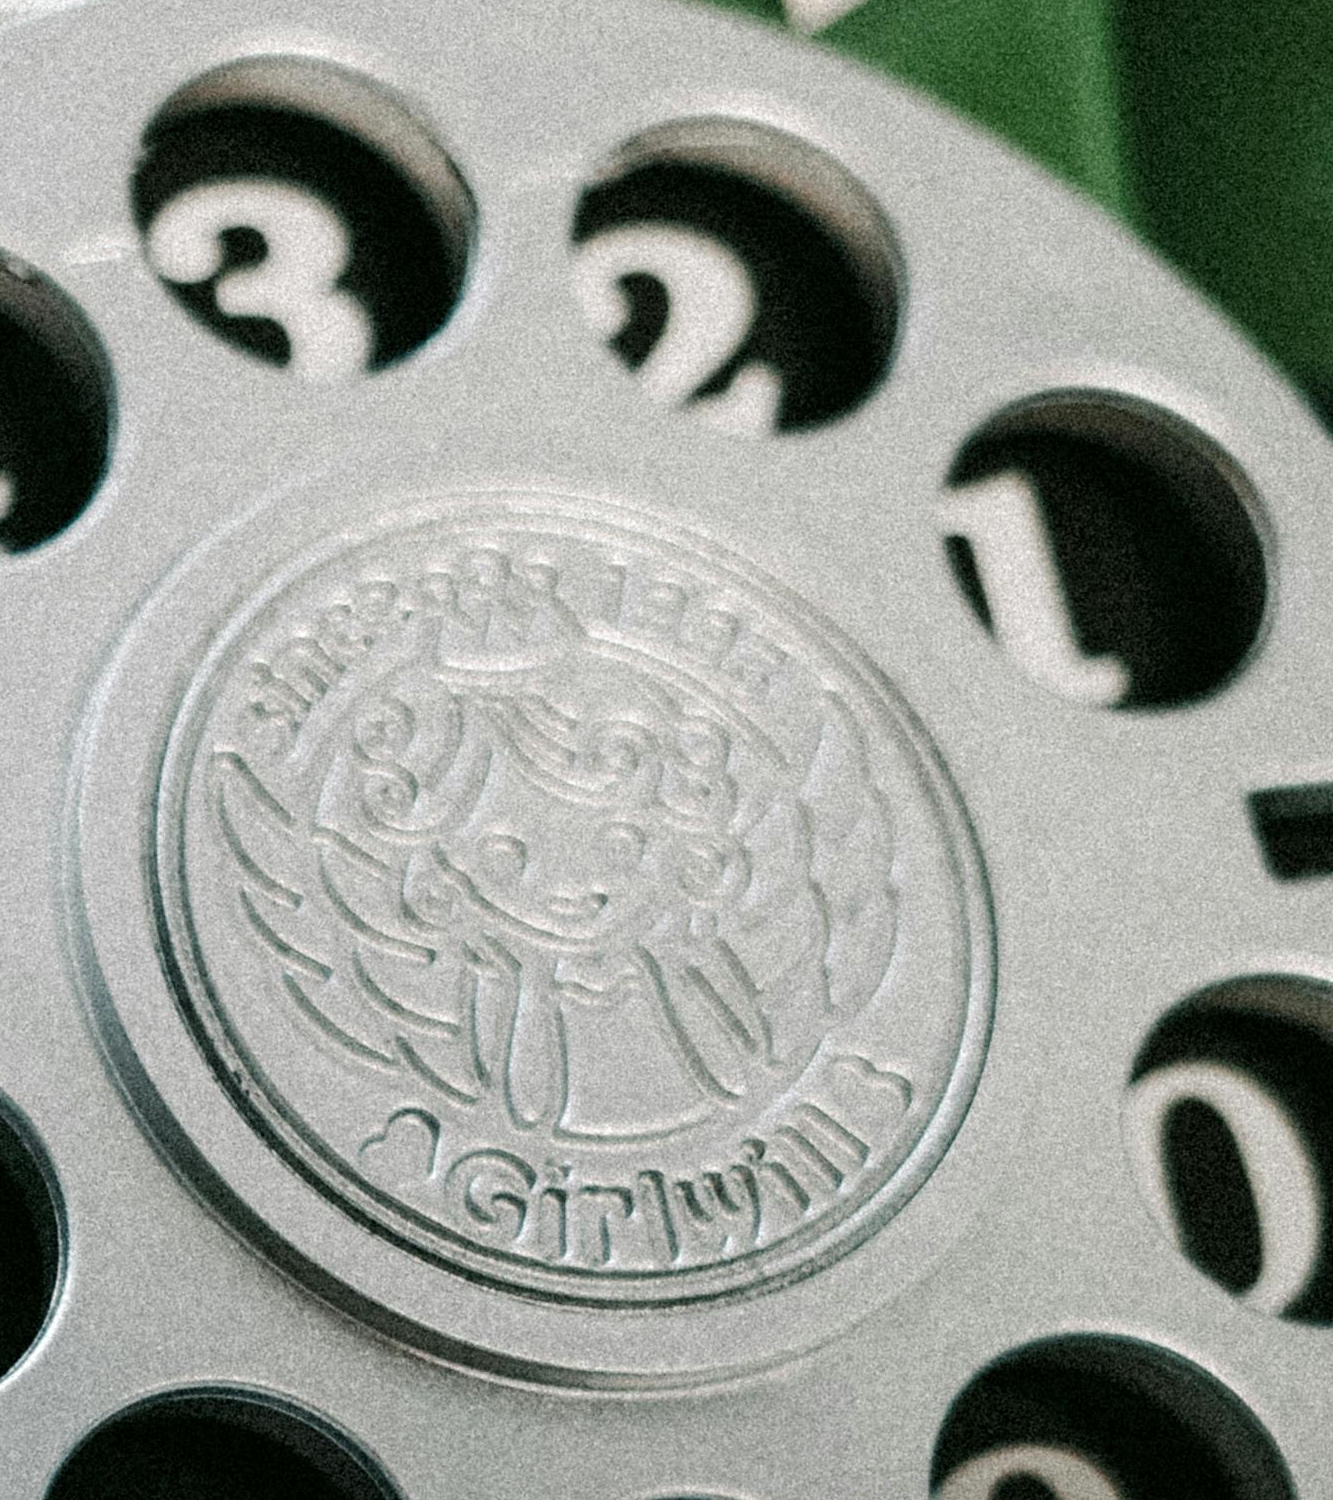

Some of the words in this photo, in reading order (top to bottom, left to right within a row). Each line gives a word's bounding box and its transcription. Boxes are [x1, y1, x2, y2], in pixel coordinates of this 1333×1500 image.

[141, 175, 376, 380] 3
[571, 220, 785, 435] 2
[938, 470, 1131, 705] 1
[1130, 1062, 1323, 1315] 0
